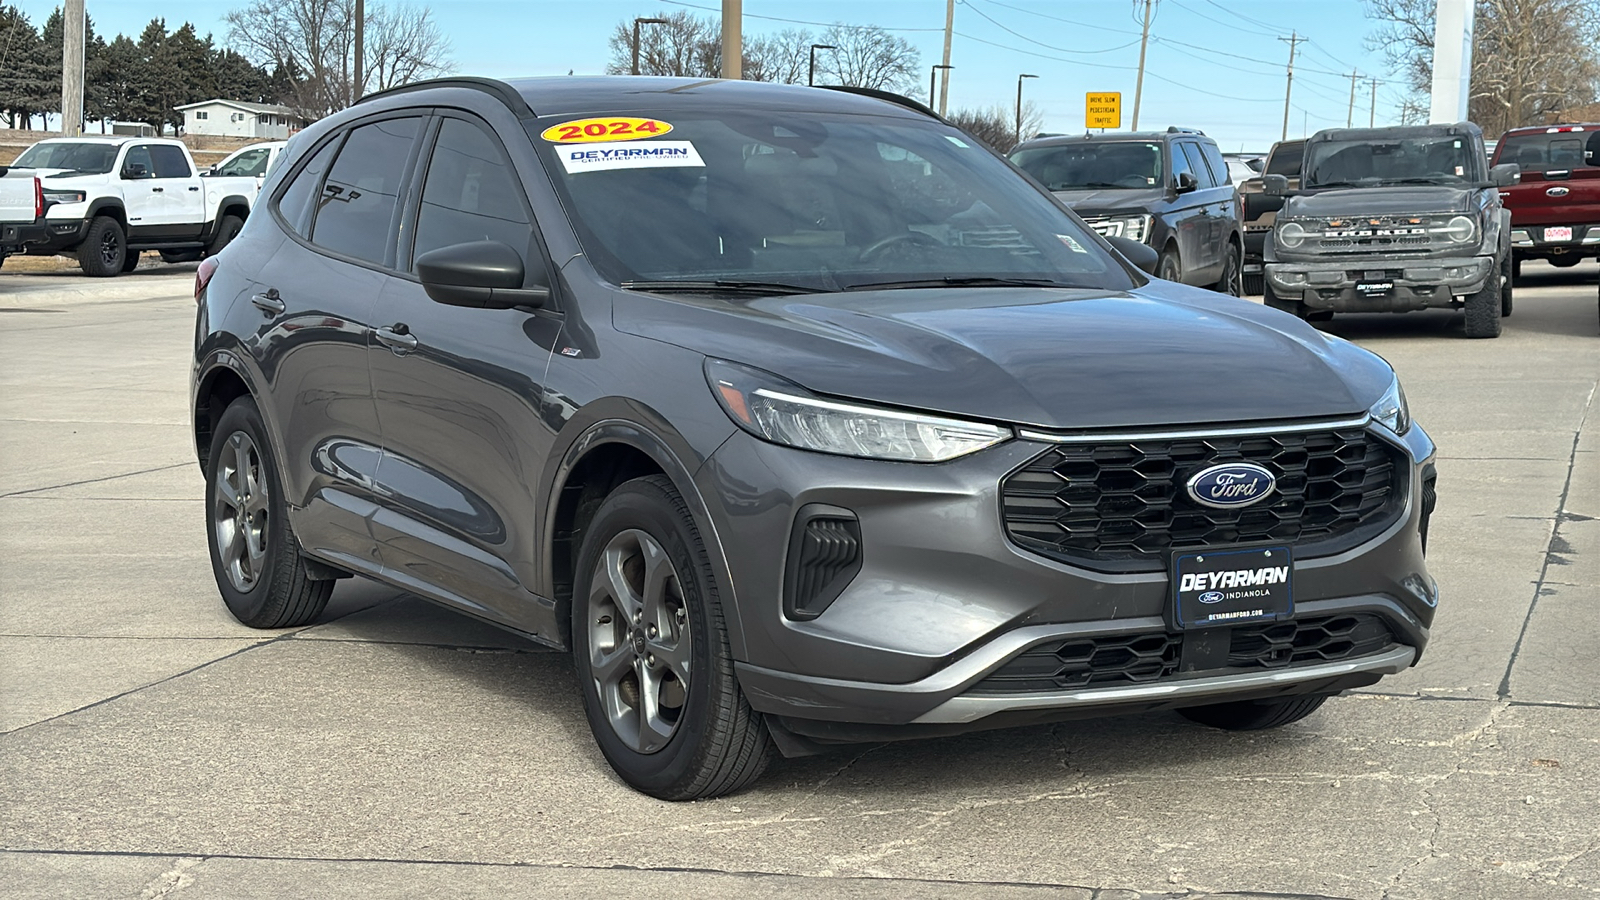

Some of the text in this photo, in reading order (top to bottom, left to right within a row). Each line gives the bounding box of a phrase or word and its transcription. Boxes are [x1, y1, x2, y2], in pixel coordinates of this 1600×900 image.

[558, 120, 661, 141] 2024
[570, 147, 688, 161] DEYARMAN
[581, 155, 631, 164] CERTIFIED
[1325, 228, 1425, 237] BRONCO
[1211, 472, 1259, 498] Ford
[1179, 566, 1289, 592] DEYARMAN
[1226, 588, 1271, 600] INDIANOLA
[1208, 609, 1263, 621] DEYARMANFORD.COM
